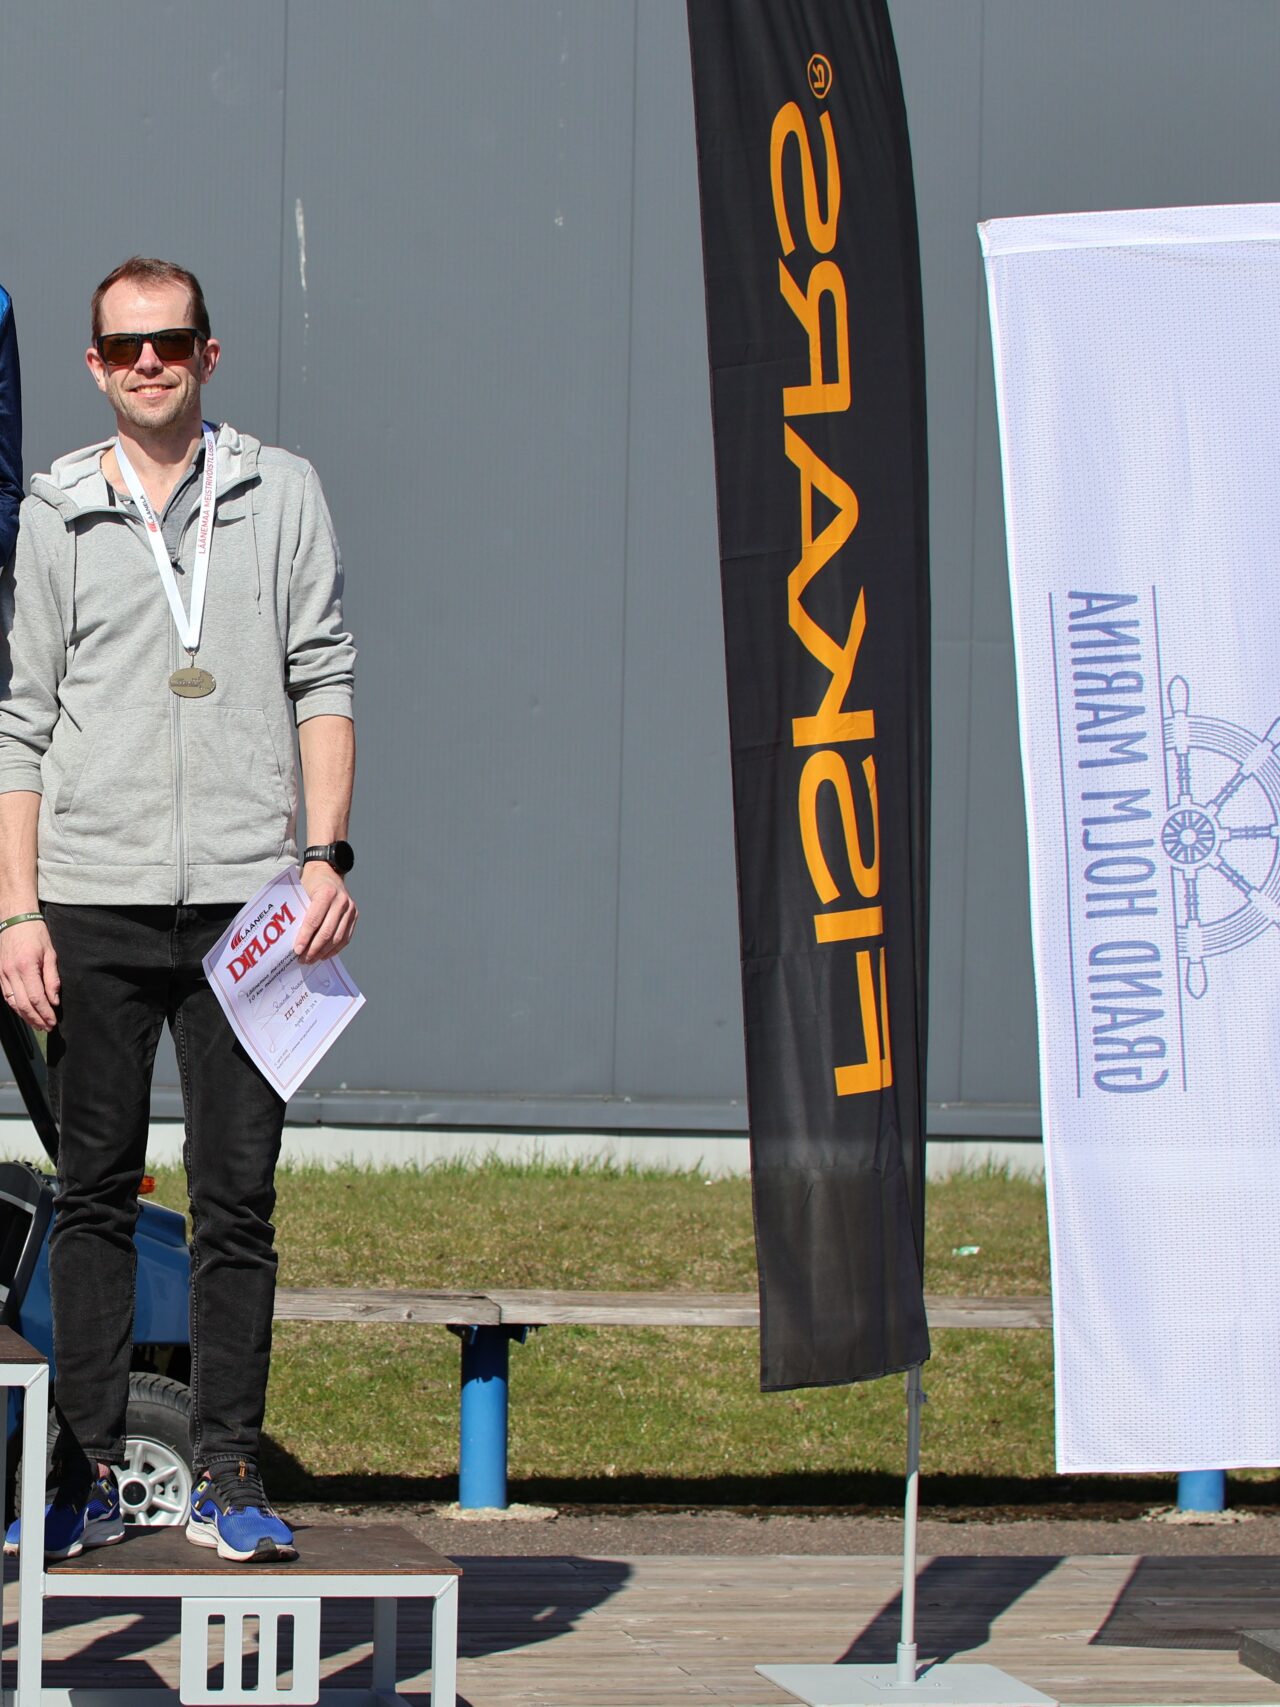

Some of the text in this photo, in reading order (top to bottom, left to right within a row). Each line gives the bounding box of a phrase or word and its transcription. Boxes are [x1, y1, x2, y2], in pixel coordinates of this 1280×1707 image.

[199, 510, 210, 554] LÄÄNEMAA
[225, 902, 296, 984] DIPLOM
[248, 994, 256, 1004] 10
[284, 1006, 295, 1021] III
[295, 991, 309, 1008] koht
[207, 1614, 295, 1691] III
